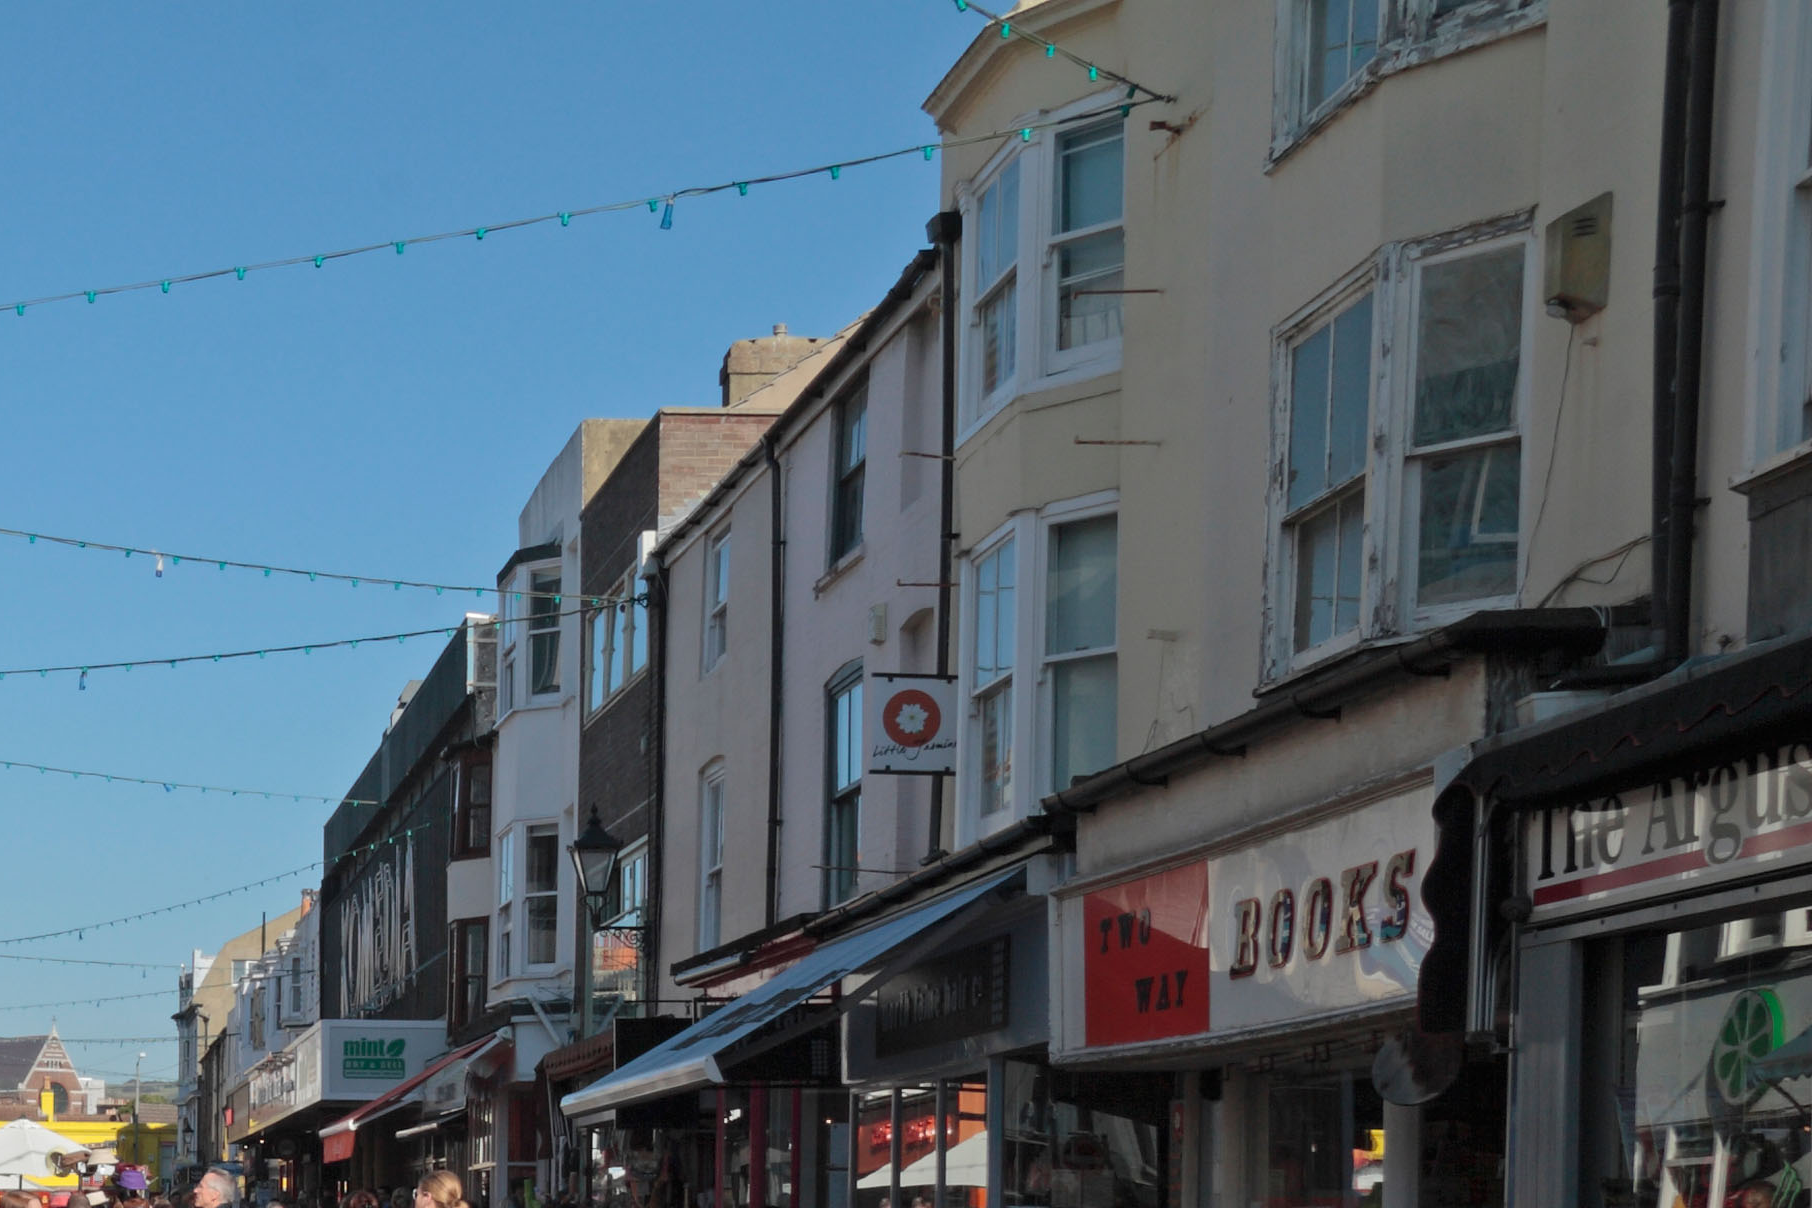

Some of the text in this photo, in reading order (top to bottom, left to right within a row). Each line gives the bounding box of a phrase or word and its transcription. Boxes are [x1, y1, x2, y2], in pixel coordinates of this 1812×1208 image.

[1641, 744, 1812, 866] Argus
[1100, 908, 1152, 954] TWO
[1230, 849, 1416, 981] BOOKS
[1135, 969, 1189, 1013] WAY
[343, 1037, 385, 1056] mint
